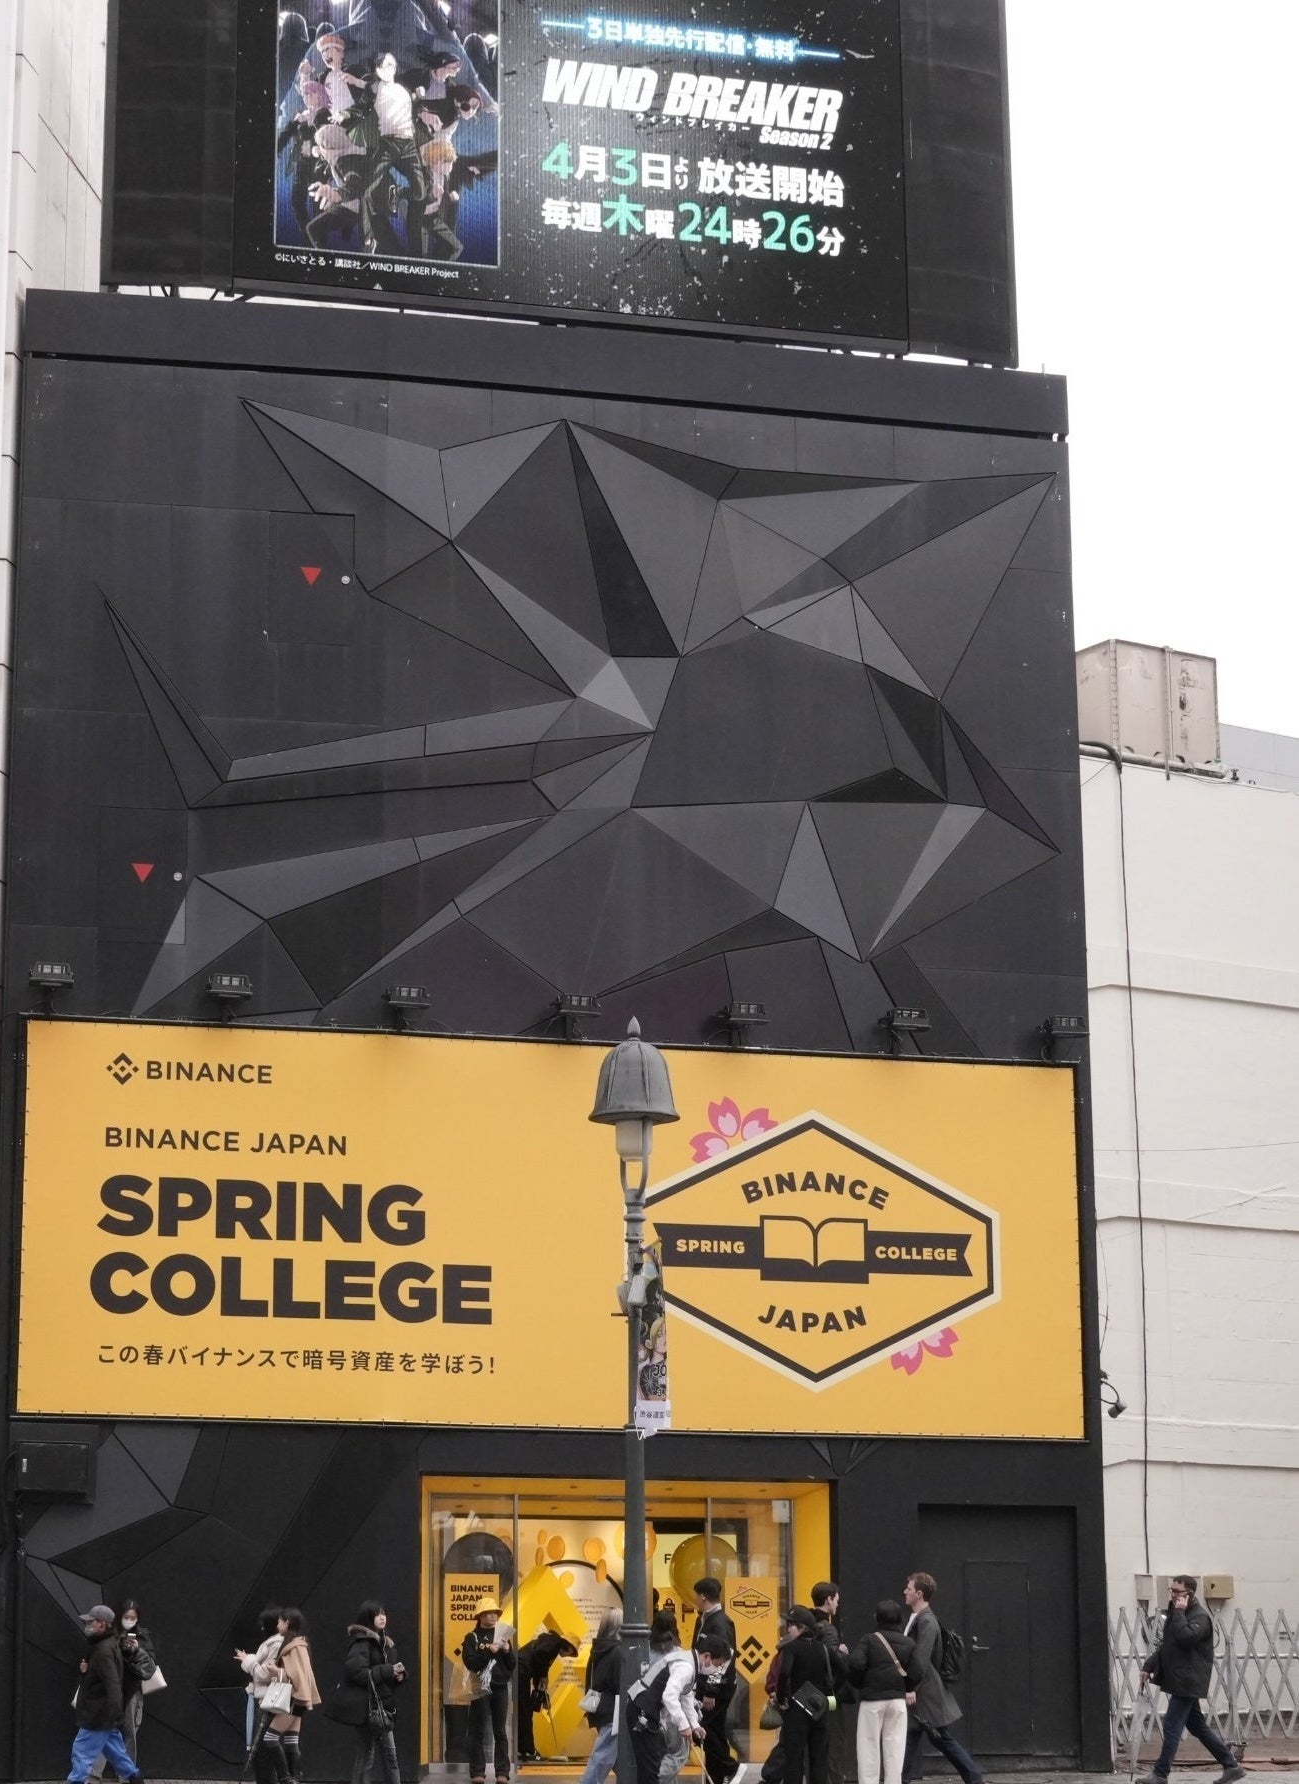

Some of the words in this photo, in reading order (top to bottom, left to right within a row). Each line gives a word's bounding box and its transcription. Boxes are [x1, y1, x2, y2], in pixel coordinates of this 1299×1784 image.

[542, 58, 658, 112] WIND
[662, 72, 843, 133] BREAKER
[759, 126, 819, 148] Season
[819, 133, 834, 150] 2
[542, 195, 845, 257] 毎週木曜24時26分
[394, 264, 430, 276] BREAKER
[431, 268, 459, 279] Project
[145, 1060, 273, 1085] BINANCE
[104, 1126, 241, 1153] BINANCE
[250, 1132, 348, 1156] JAPAN
[741, 1171, 890, 1211] BINANCE
[97, 1174, 426, 1246] SPRING
[675, 1238, 746, 1255] SPRING
[874, 1245, 958, 1262] COLLEGE
[90, 1251, 493, 1325] COLLEGE
[758, 1304, 867, 1334] JAPAN
[450, 1584, 494, 1593] BINANCE
[450, 1594, 483, 1602] JAPAN
[450, 1613, 477, 1621] COLL
